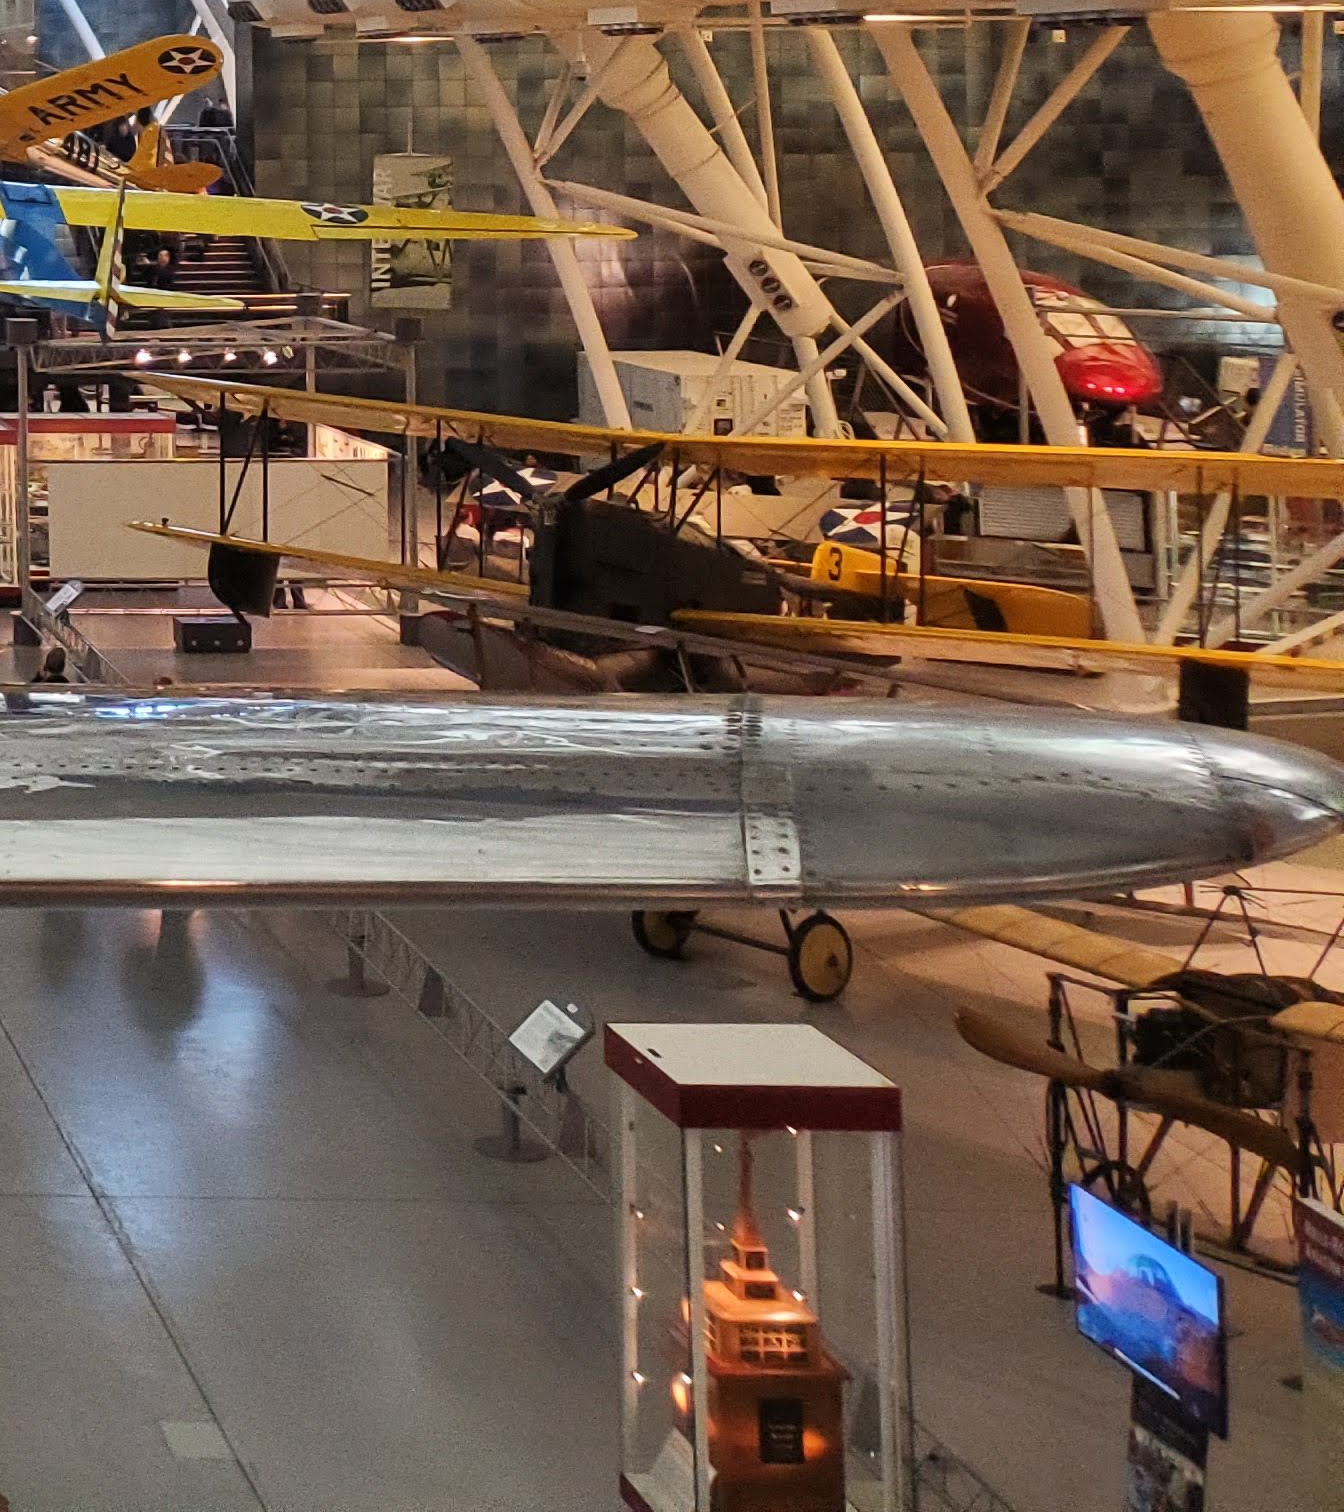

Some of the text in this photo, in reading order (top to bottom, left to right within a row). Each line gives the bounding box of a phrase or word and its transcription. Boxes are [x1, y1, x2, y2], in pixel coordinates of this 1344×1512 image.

[26, 72, 146, 126] ARMY
[371, 168, 392, 288] INTEAR
[827, 546, 843, 581] 3
